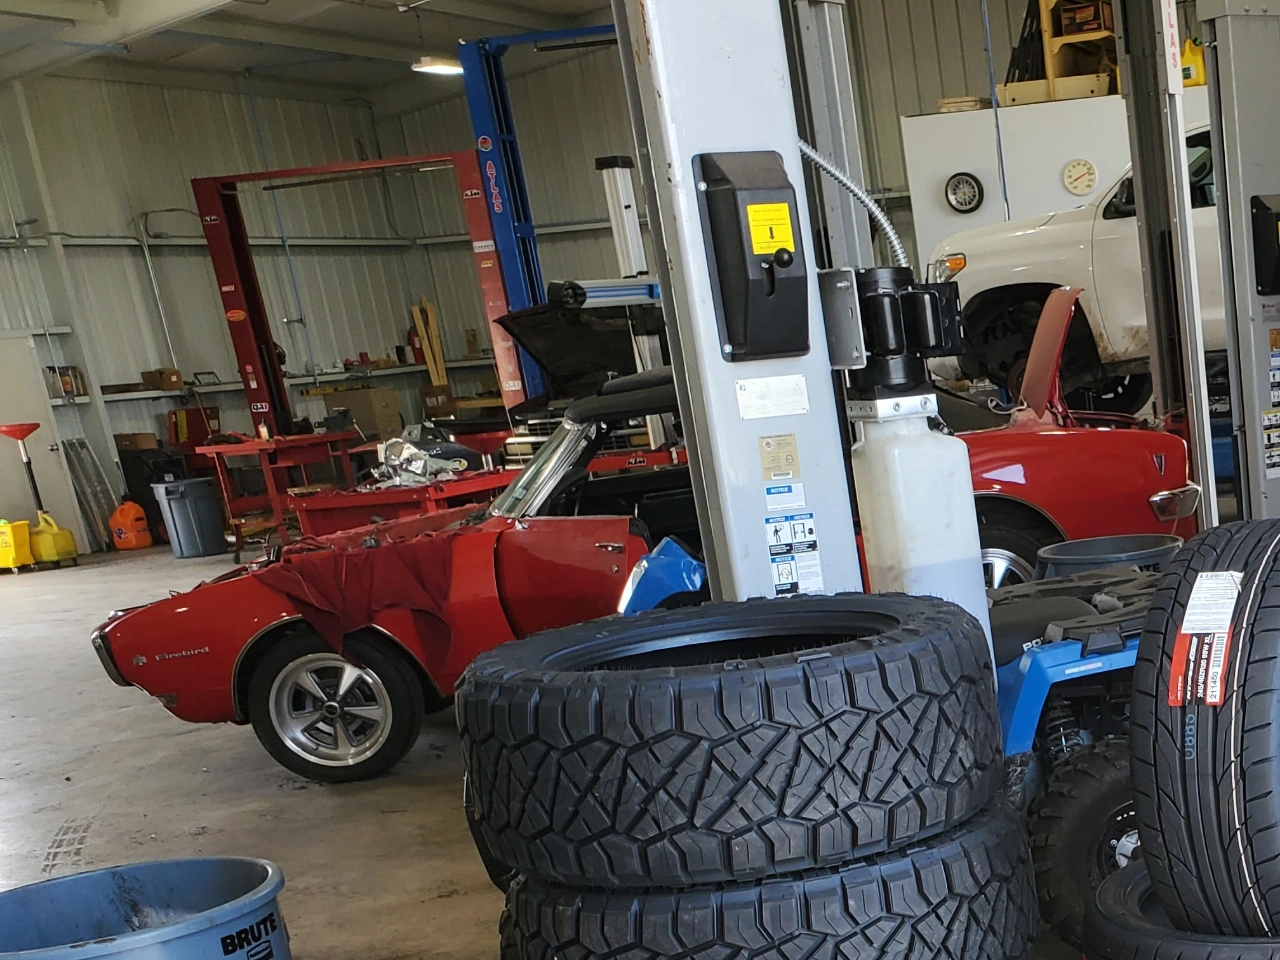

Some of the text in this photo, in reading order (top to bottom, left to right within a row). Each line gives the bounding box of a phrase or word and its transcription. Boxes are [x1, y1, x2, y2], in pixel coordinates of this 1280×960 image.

[487, 161, 503, 213] ATLAS
[155, 646, 209, 661] Firebird
[1209, 671, 1219, 699] 211450
[221, 912, 278, 956] BRUTE
